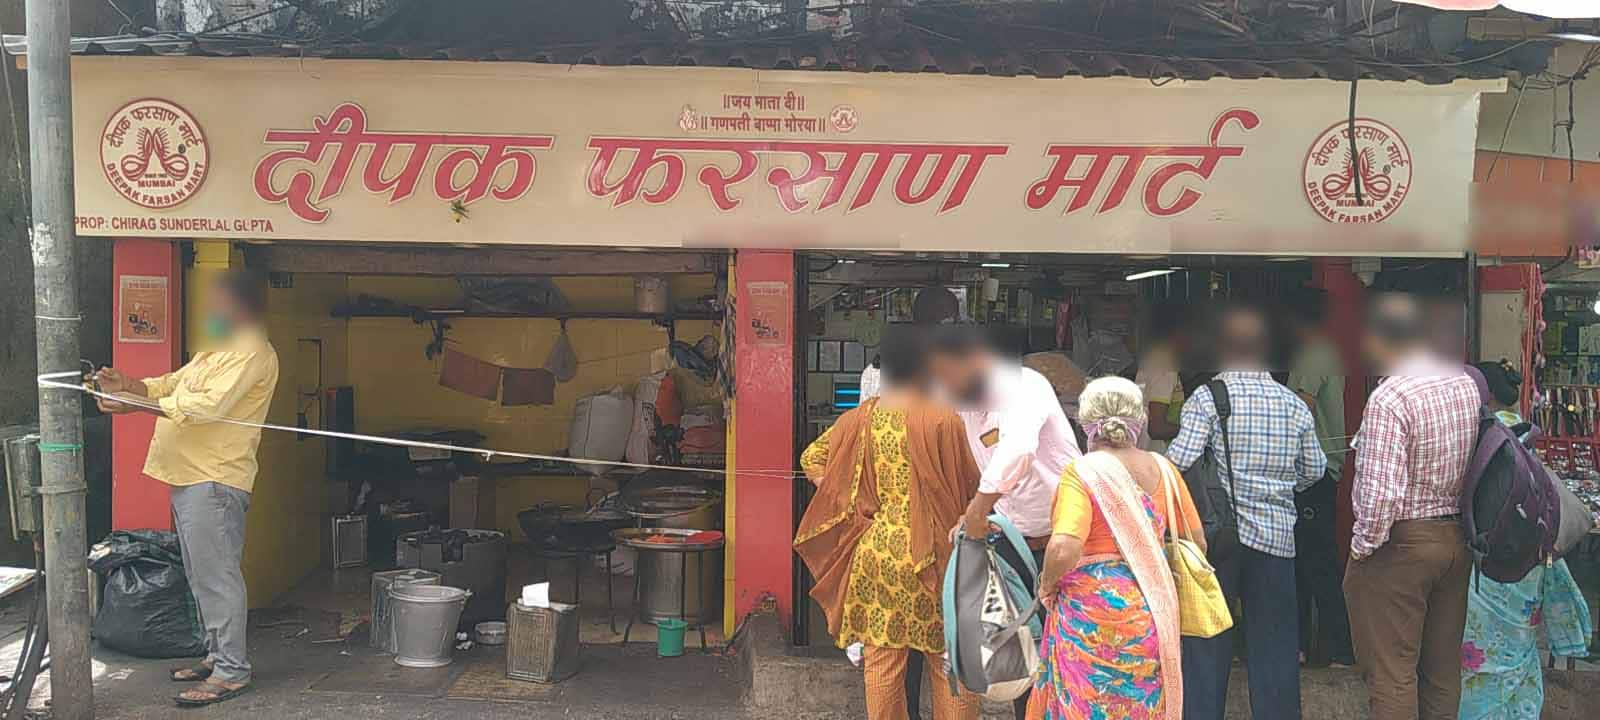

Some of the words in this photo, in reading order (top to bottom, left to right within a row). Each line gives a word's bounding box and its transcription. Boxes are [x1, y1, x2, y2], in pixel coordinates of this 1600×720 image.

[754, 95, 780, 110] माता
[106, 116, 131, 148] दीपक
[130, 106, 180, 126] फरसाण
[179, 121, 203, 148] मार्ट
[252, 102, 556, 223] दीपक
[584, 136, 1010, 214] फरसाण
[1025, 107, 1261, 216] मार्ट
[1312, 134, 1340, 166] दीपक
[1386, 142, 1409, 168] मार्ट
[107, 163, 141, 200] DEEPAK
[142, 191, 185, 205] FARSAN
[184, 162, 204, 190] MART
[138, 180, 176, 188] MUMBAI
[1308, 181, 1339, 219] DEEPAK
[1338, 208, 1383, 224] FARSAN
[1382, 182, 1406, 210] MART
[74, 216, 109, 229] PROP:
[112, 216, 156, 230] CHIRAG
[160, 218, 230, 231] SUNDERLAL
